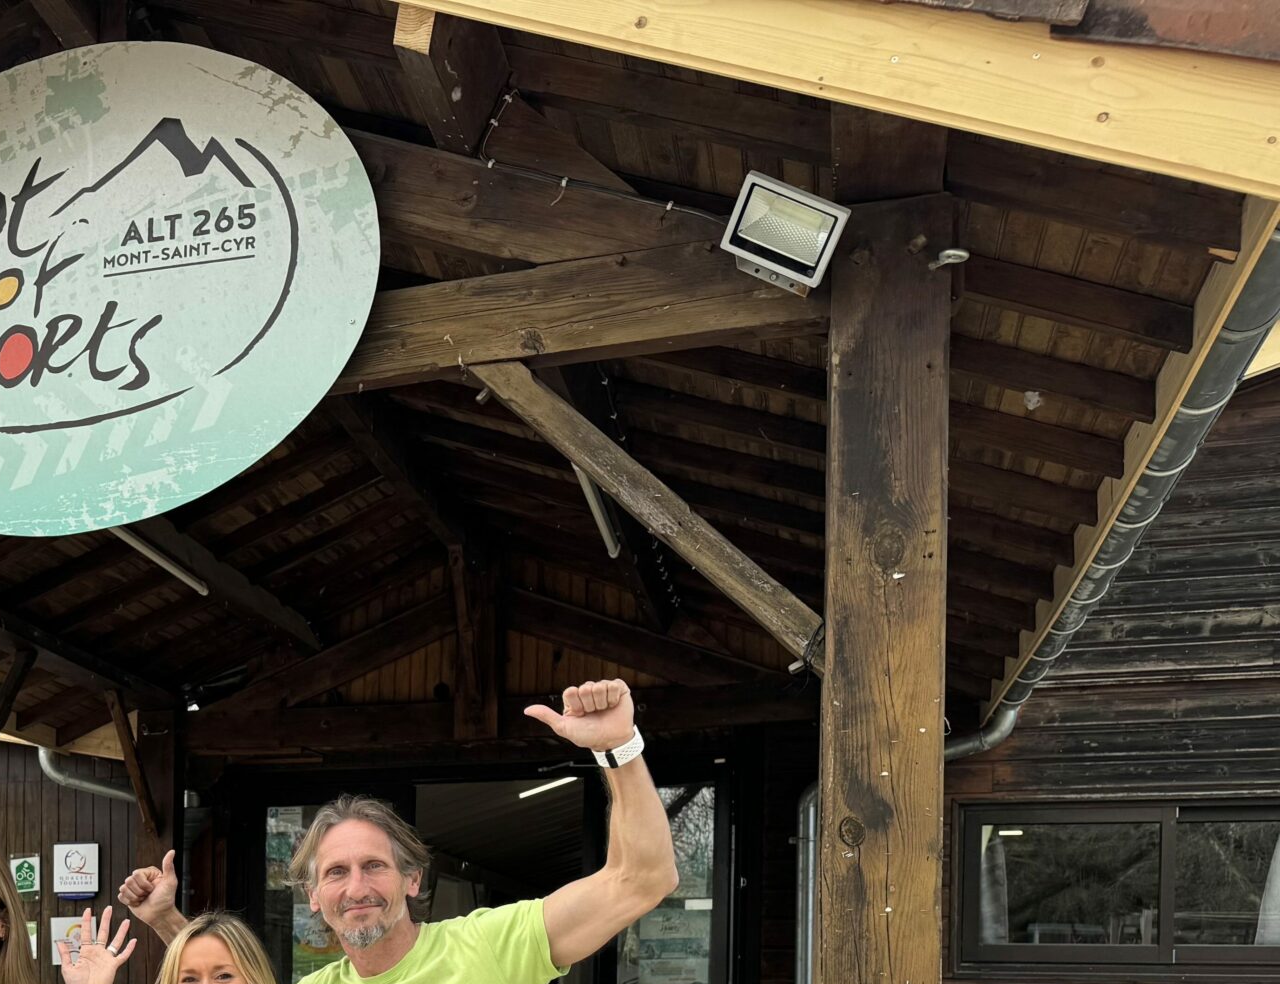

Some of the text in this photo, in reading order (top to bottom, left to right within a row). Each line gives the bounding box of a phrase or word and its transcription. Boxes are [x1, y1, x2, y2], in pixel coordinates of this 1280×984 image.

[120, 203, 257, 247] ALT 265
[103, 236, 256, 269] MONT-SAINT-CYR
